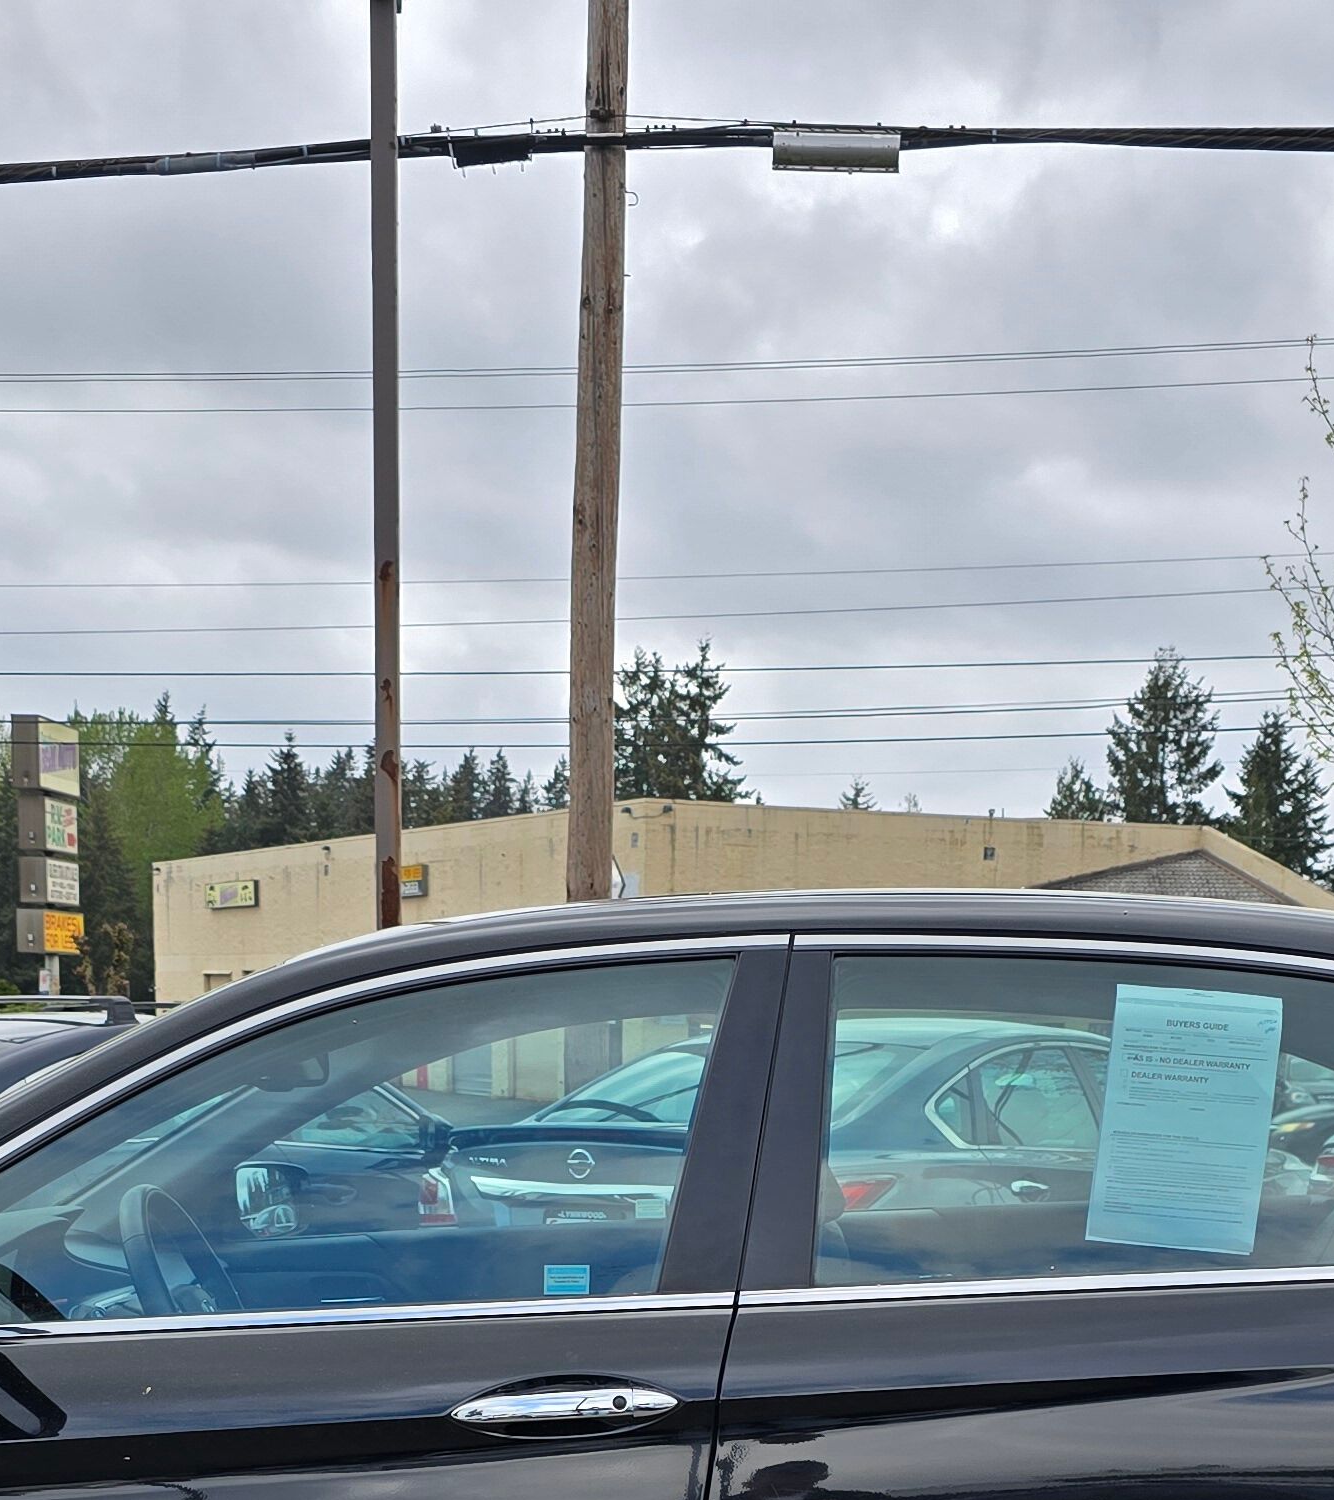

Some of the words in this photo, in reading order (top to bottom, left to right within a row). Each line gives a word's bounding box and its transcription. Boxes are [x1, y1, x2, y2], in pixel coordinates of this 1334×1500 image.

[1167, 1019, 1200, 1029] BUYERS
[1203, 1022, 1229, 1031] GUIDE
[1145, 1055, 1153, 1063] IS
[1159, 1056, 1171, 1064] NO
[1173, 1058, 1205, 1067] DEALER
[1206, 1061, 1250, 1070] WARRANTY
[1131, 1071, 1162, 1080] DEALER
[1164, 1074, 1209, 1083] WARRANTY
